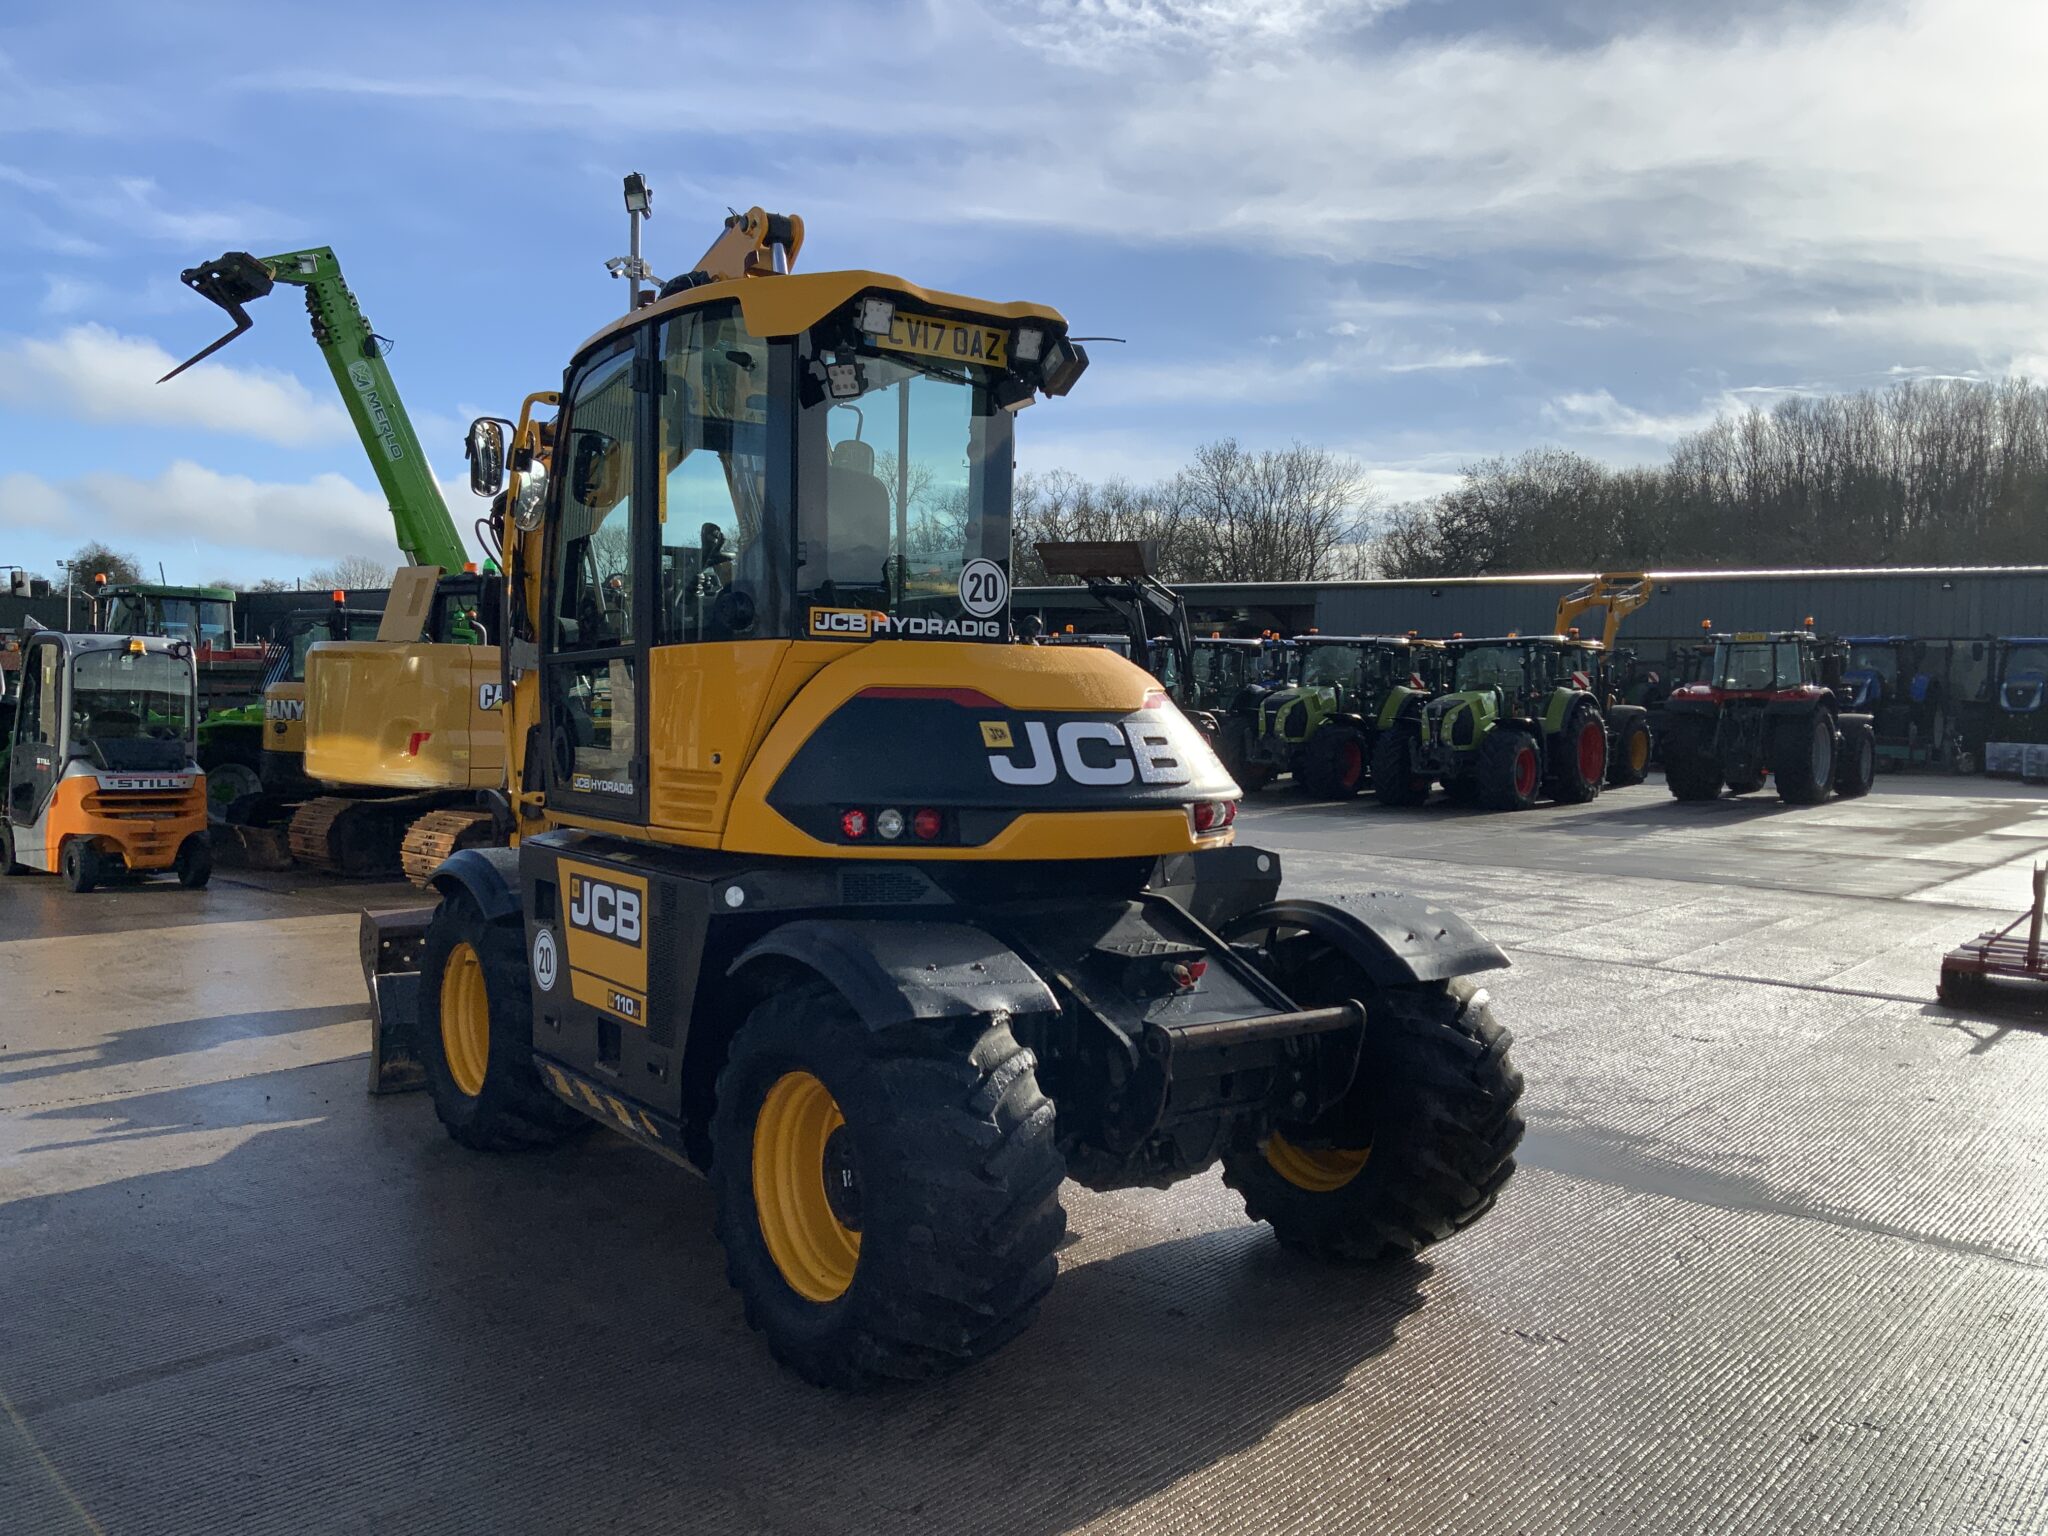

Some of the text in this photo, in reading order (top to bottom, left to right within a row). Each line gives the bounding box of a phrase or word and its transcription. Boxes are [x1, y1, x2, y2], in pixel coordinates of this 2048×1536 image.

[888, 315, 945, 351] CV17
[367, 391, 403, 459] MERLO
[968, 572, 998, 602] 20
[815, 612, 1000, 637] JCB HYDRADIG
[989, 721, 1192, 785] JCB
[117, 779, 180, 788] STILL
[574, 777, 634, 795] JCB HYDRADIG
[571, 880, 641, 942] JCB
[539, 946, 552, 974] 20
